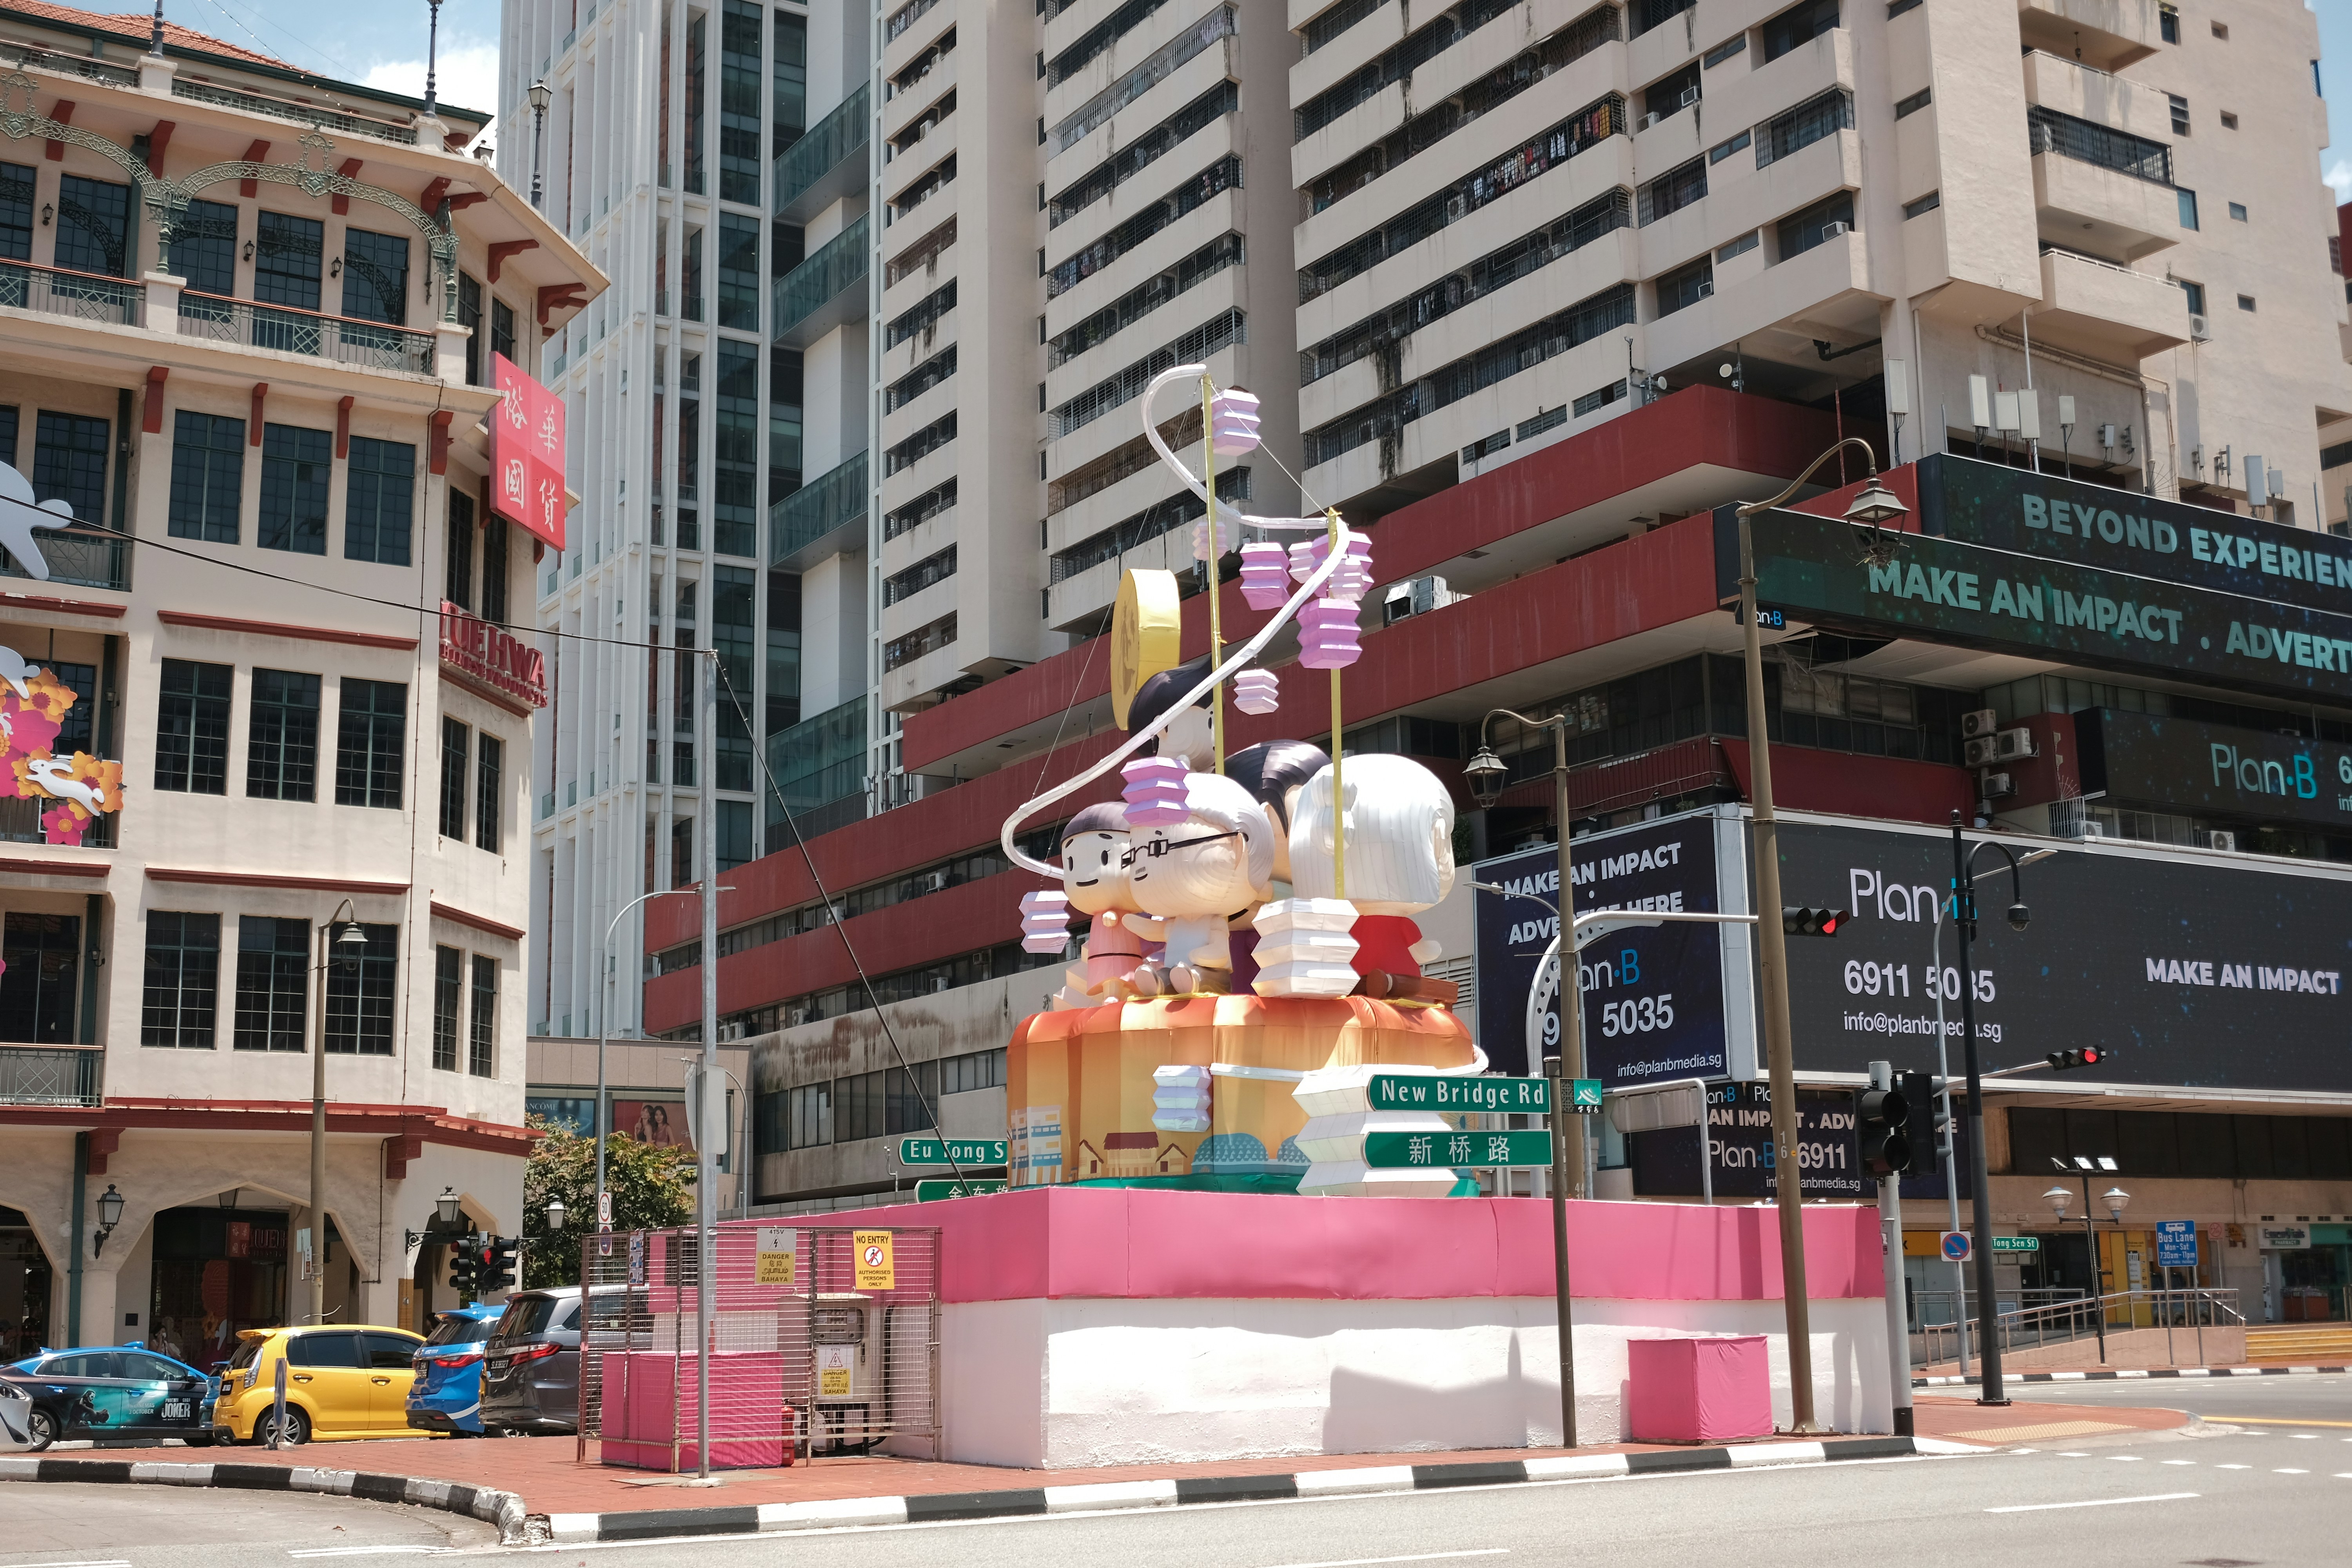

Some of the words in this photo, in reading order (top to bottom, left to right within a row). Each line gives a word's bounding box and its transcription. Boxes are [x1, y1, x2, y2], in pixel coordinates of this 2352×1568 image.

[2022, 493, 2178, 554] BEYOND
[2190, 527, 2352, 588] EXPERIEN
[1869, 559, 1981, 611] MAKE
[1989, 579, 2044, 622] AN
[2053, 589, 2183, 645] IMPACT
[2225, 621, 2352, 674] ADVERT
[1504, 869, 1559, 901] MAKE
[1570, 862, 1595, 886] AN
[1601, 842, 1681, 880] IMPACT
[1844, 960, 1909, 997] 6911
[2146, 958, 2214, 986] MAKE
[2220, 964, 2252, 989] AN
[2258, 966, 2339, 995] IMPACT
[1602, 993, 1674, 1037] 5035
[1617, 1053, 1722, 1078] info@planbmedia.sg
[1382, 1080, 1426, 1102] New
[1437, 1081, 1510, 1109] Bridge
[1519, 1083, 1544, 1105] Rd
[1708, 1109, 1733, 1126] AN
[1739, 1110, 1804, 1129] IMPT
[910, 1141, 931, 1158] Eu
[943, 1142, 985, 1163] Tong
[994, 1142, 1004, 1159] S
[1409, 1135, 1511, 1164] 新桥路
[1797, 1142, 1846, 1169] 6911
[602, 1202, 607, 1214] 50
[856, 1236, 866, 1244] NO
[867, 1236, 889, 1244] ENTRY
[1993, 1238, 2009, 1249] Tong
[2012, 1238, 2024, 1247] Sen
[2027, 1239, 2035, 1247] St
[2158, 1232, 2172, 1243] Bus
[2175, 1231, 2194, 1242] Lane
[161, 1402, 191, 1418] JOKER
